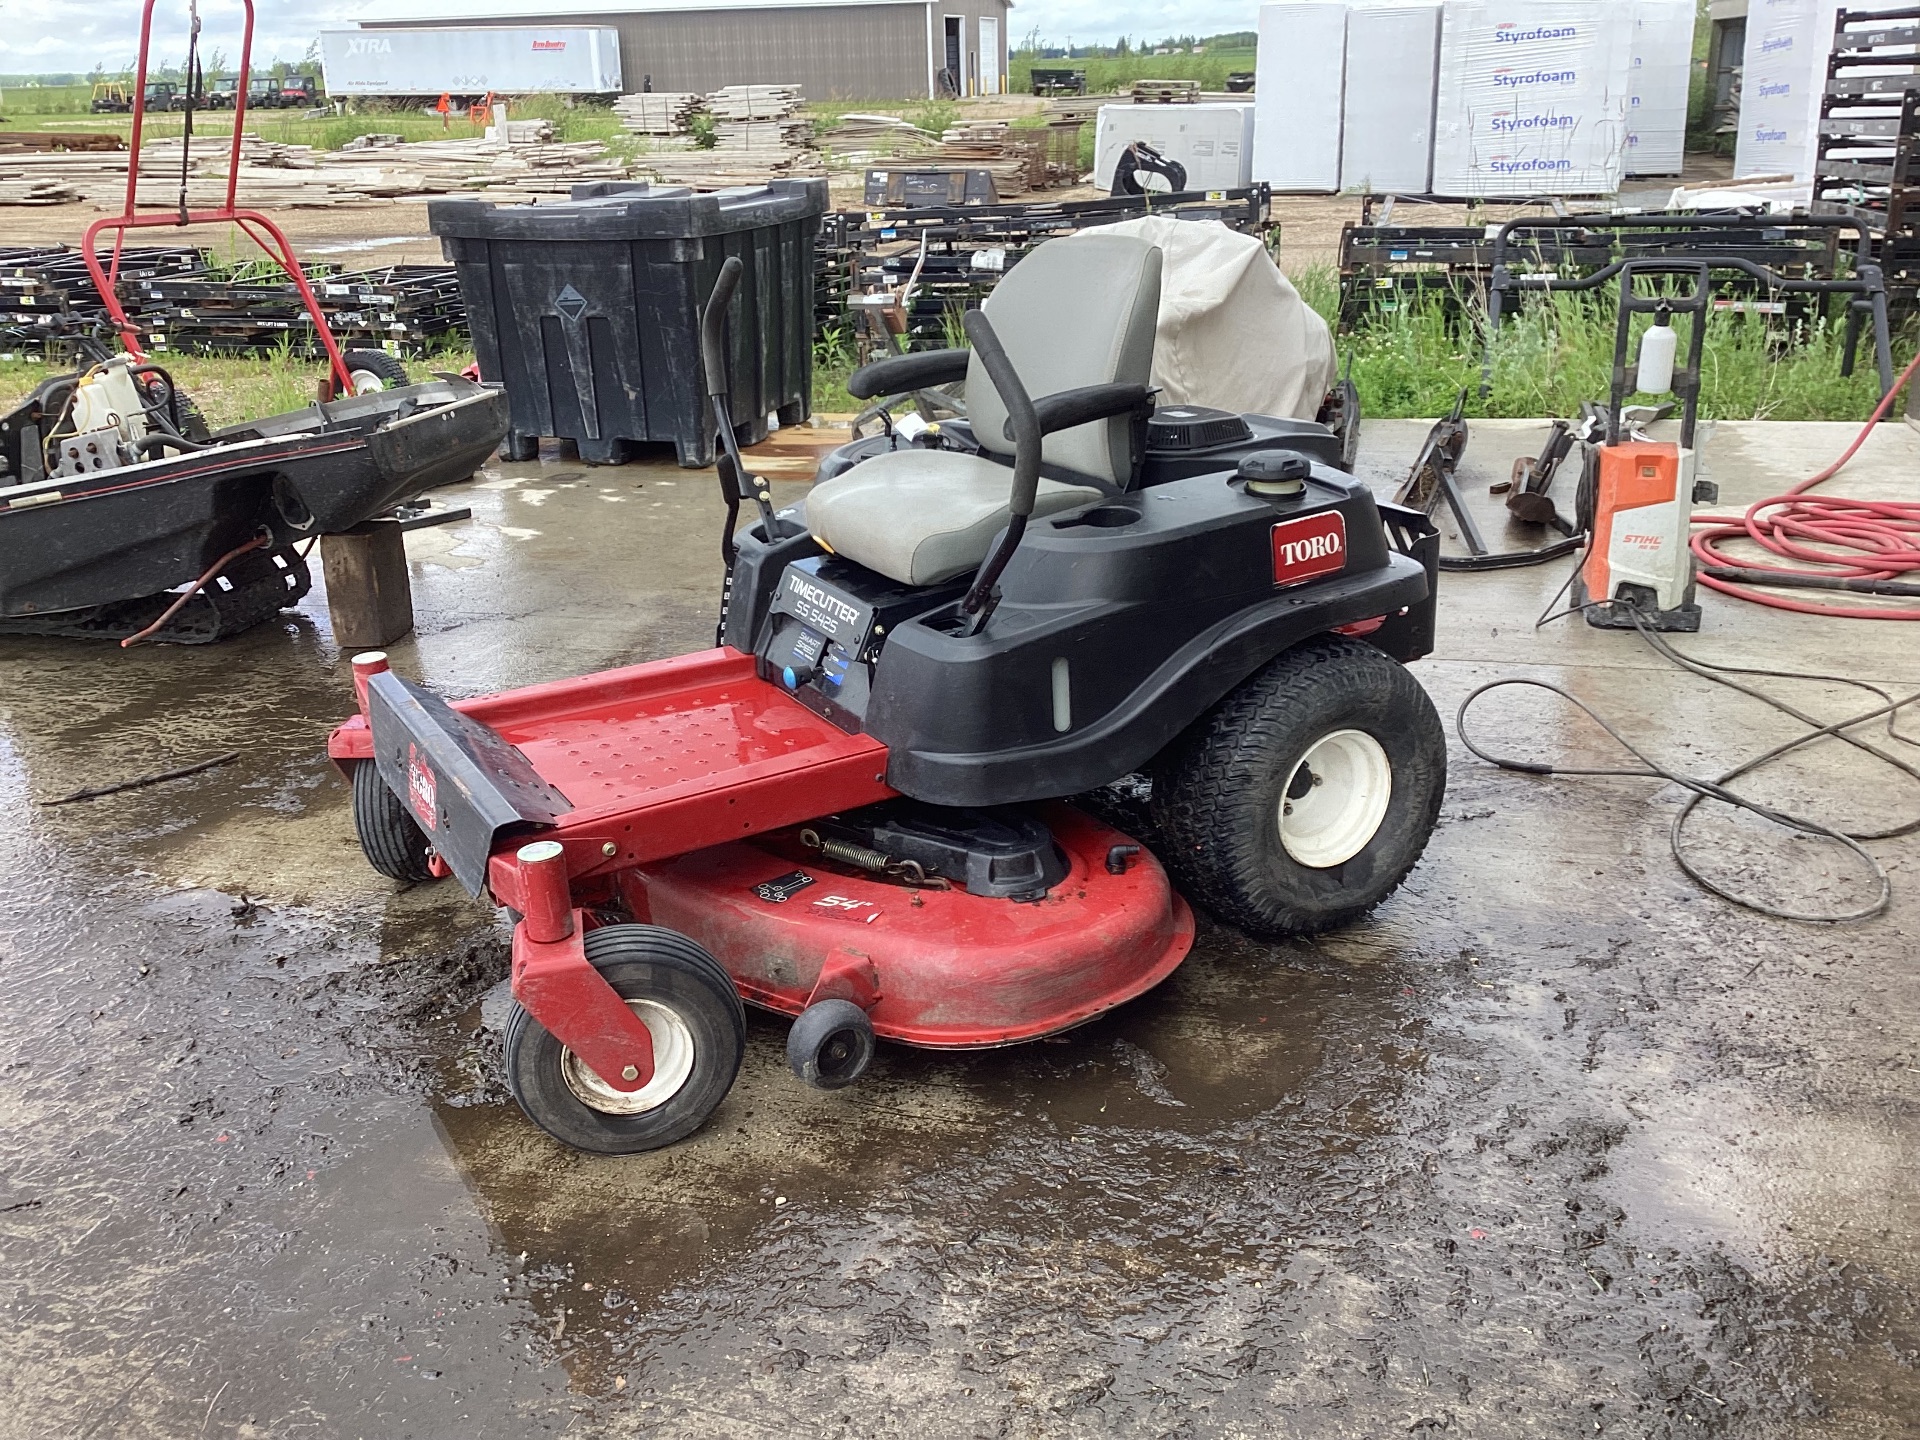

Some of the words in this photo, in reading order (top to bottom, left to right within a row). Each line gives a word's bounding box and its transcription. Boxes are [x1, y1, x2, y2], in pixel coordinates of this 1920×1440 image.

[1496, 27, 1576, 44] Styrofoam
[344, 37, 392, 58] XTRA
[1493, 70, 1576, 88] Styrofoam
[1492, 114, 1573, 131] Styrofoam
[1755, 128, 1787, 144] Styrofoam
[1490, 158, 1571, 174] Styrofoam
[1280, 532, 1340, 566] TORO
[1623, 535, 1661, 545] STIHL
[789, 574, 859, 626] TIMECUTTER
[794, 600, 811, 618] SS
[809, 608, 839, 634] 5425
[798, 631, 821, 649] SMART
